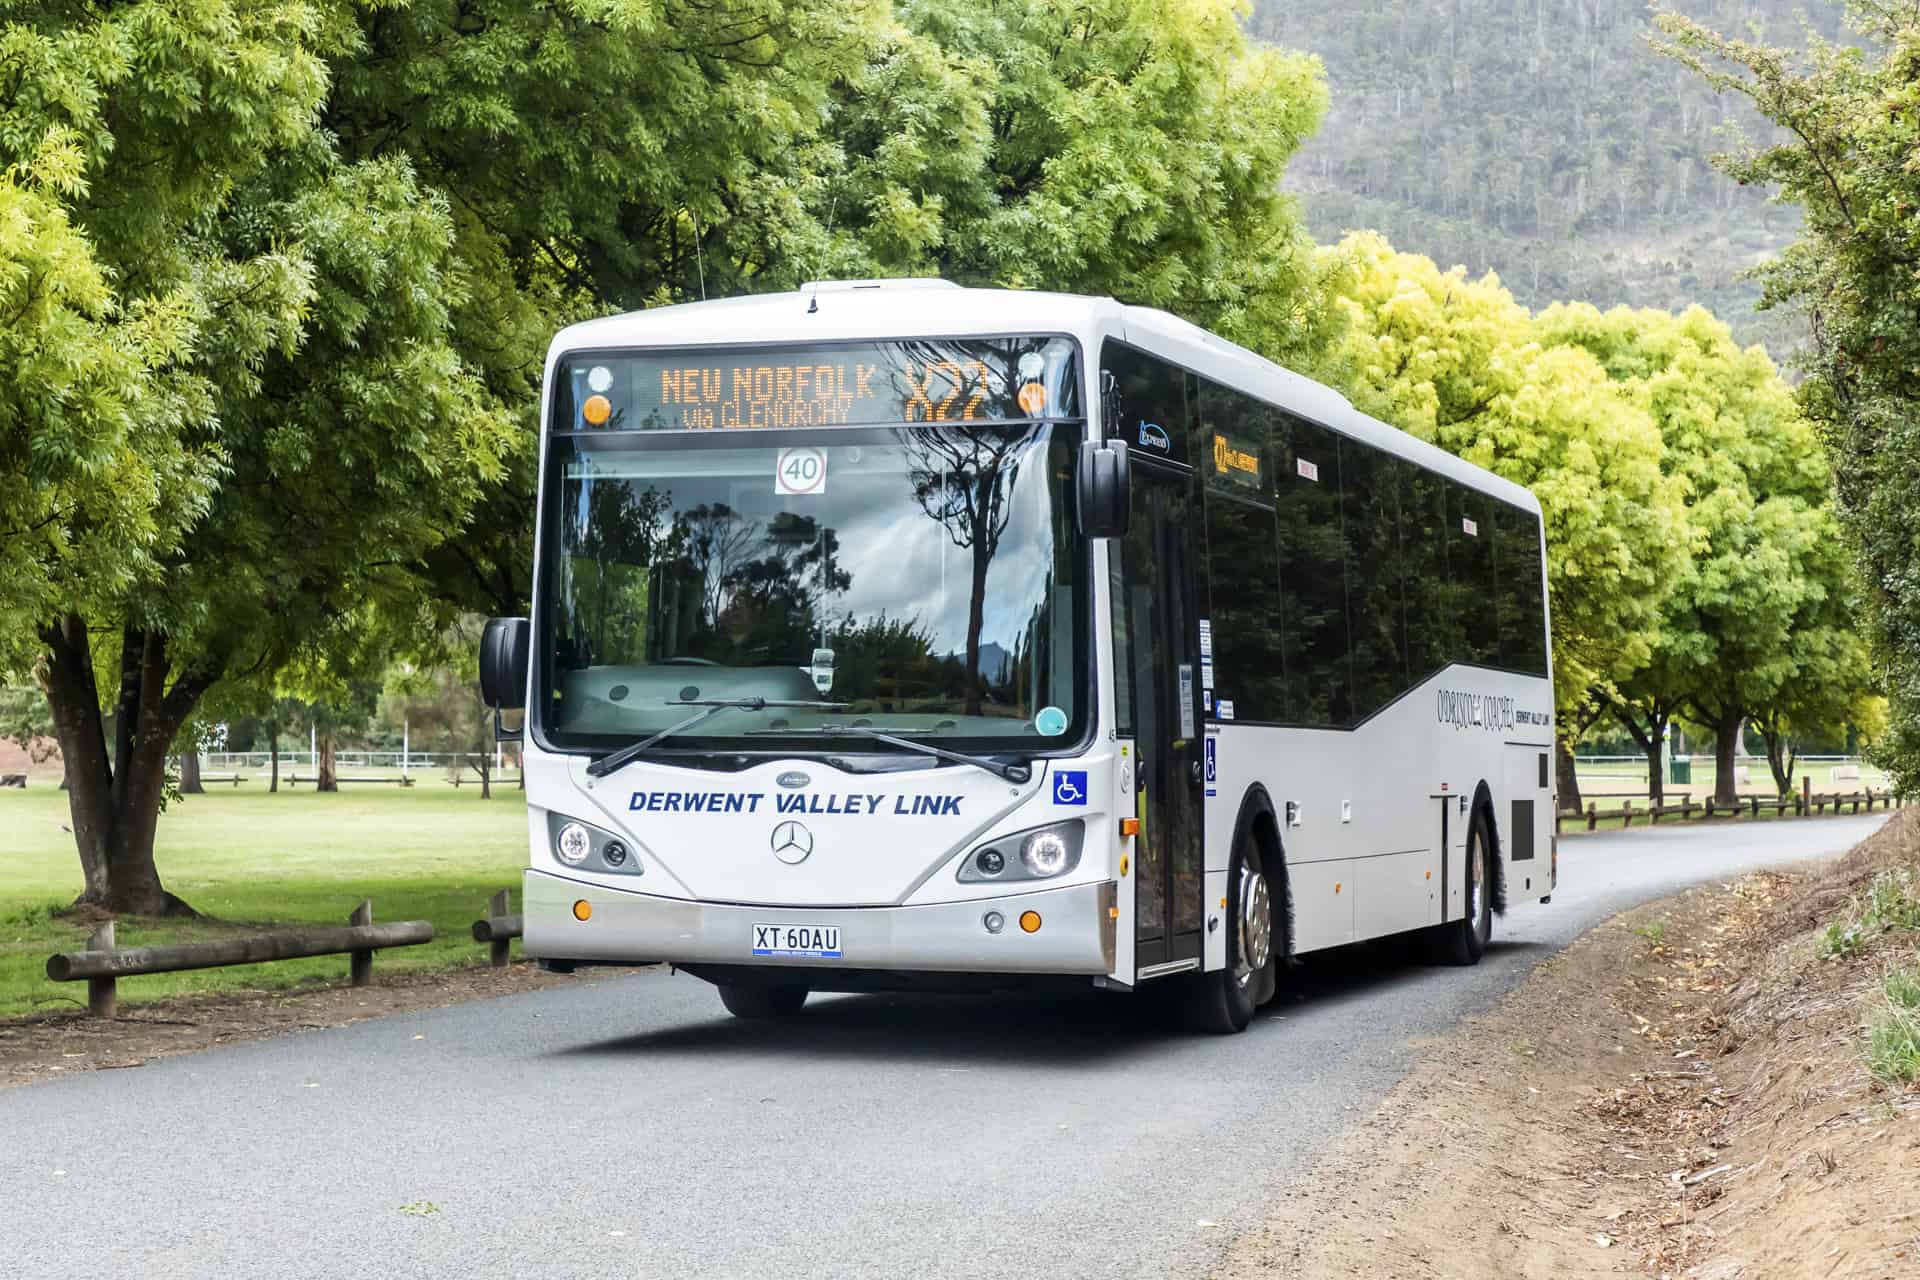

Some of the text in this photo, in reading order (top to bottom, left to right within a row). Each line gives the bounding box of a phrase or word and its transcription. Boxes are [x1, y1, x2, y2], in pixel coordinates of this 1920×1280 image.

[661, 363, 876, 403] NEW NORFOLK
[683, 397, 851, 429] via GLENORCHY
[784, 457, 818, 480] 40
[628, 791, 965, 815] DERWENT VALLEY LINK
